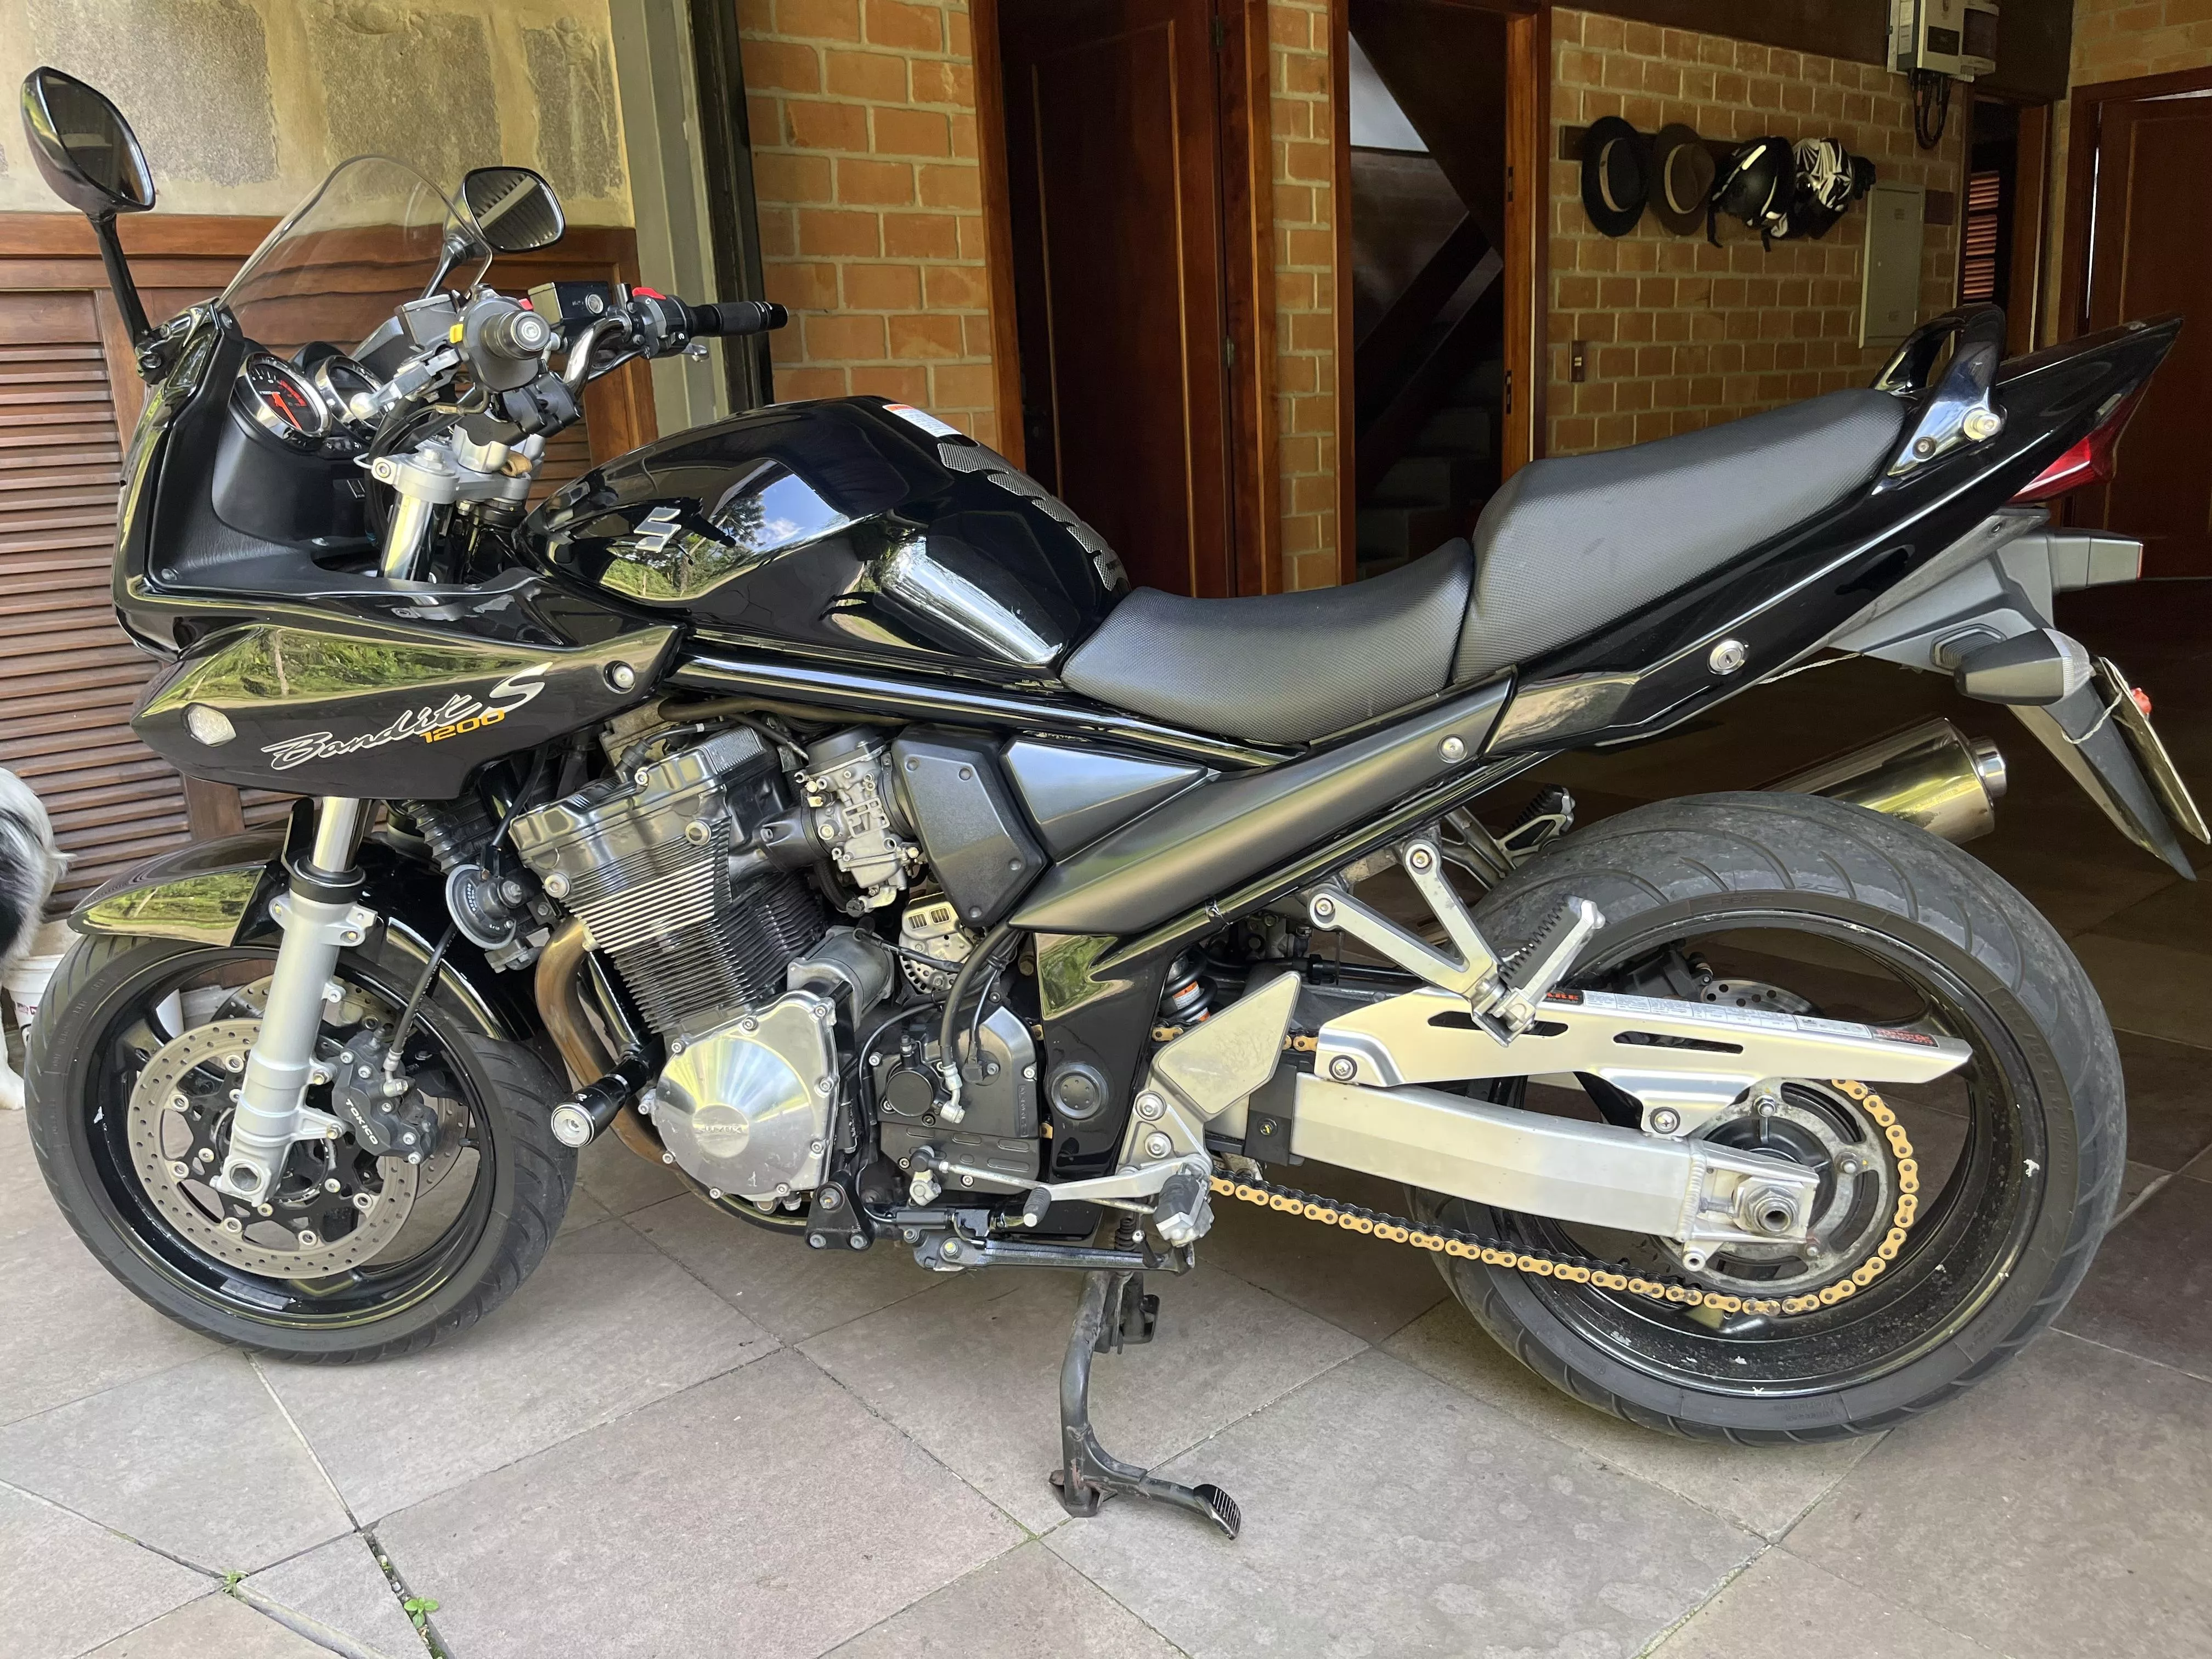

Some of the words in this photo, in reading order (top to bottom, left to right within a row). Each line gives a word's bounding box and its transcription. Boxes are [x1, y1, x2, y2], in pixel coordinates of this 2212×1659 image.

[261, 694, 483, 770] Bandit
[478, 662, 554, 719] S
[419, 709, 506, 743] 1200
[345, 1098, 379, 1146] TOKICO
